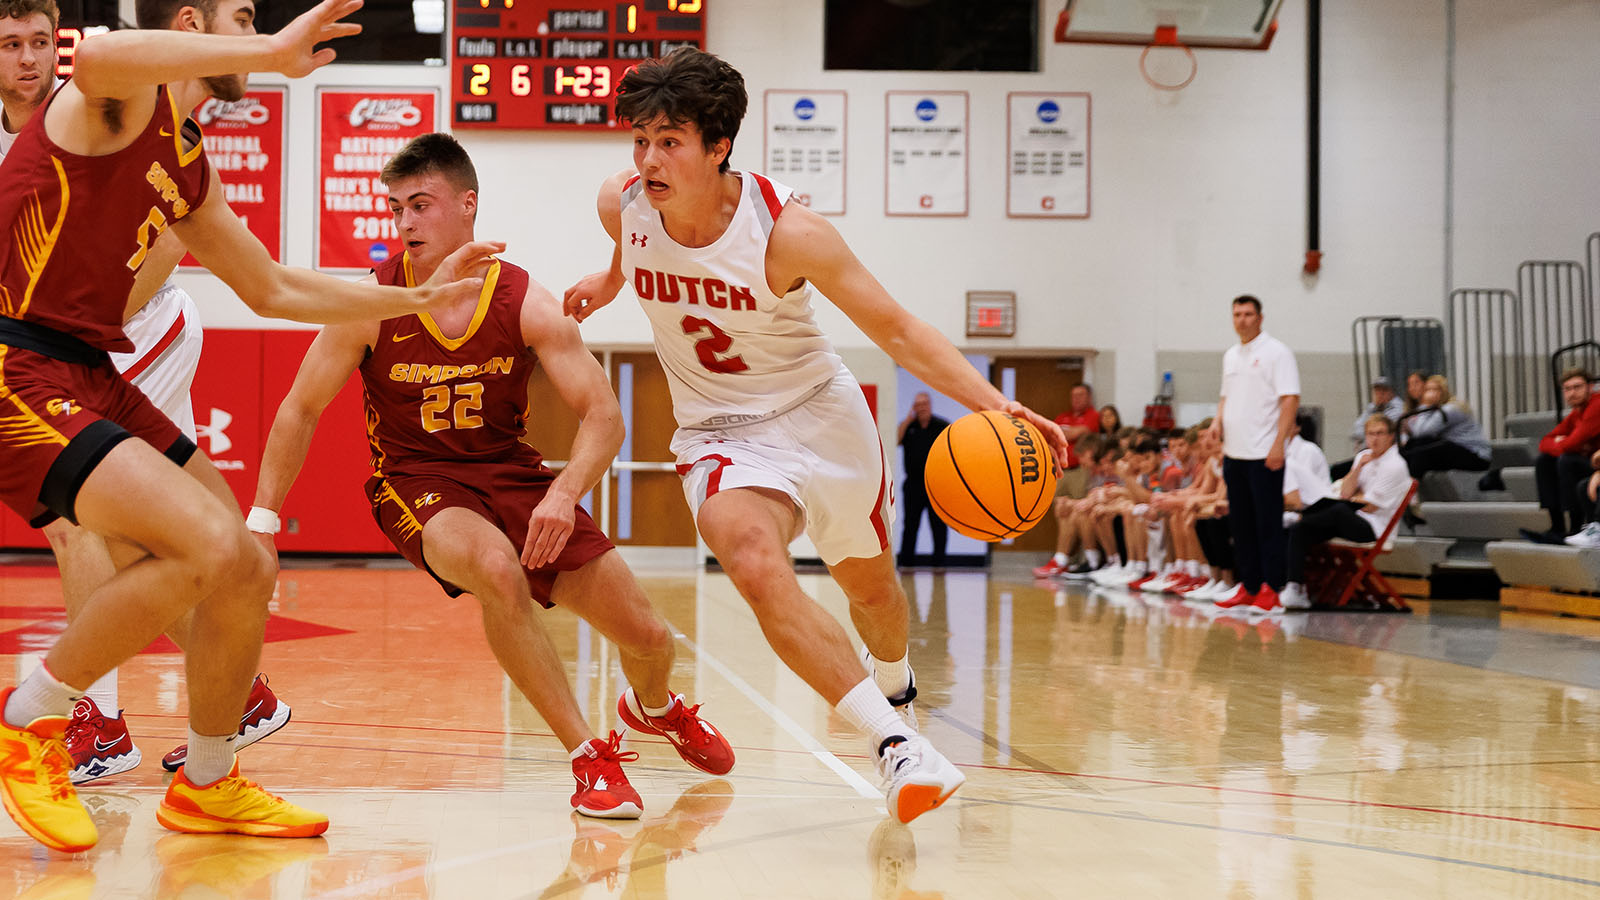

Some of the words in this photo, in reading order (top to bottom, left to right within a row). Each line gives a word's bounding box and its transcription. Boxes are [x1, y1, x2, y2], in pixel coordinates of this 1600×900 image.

[553, 10, 604, 31] period
[459, 37, 496, 57] fouls
[552, 37, 604, 60] player
[470, 64, 491, 96] 2
[511, 64, 532, 96] 6
[551, 103, 600, 125] weight
[325, 194, 373, 212] TRACK
[634, 266, 758, 312] DUTCH
[680, 313, 752, 375] 2
[388, 356, 515, 384] SIMPSON
[420, 381, 485, 434] 22
